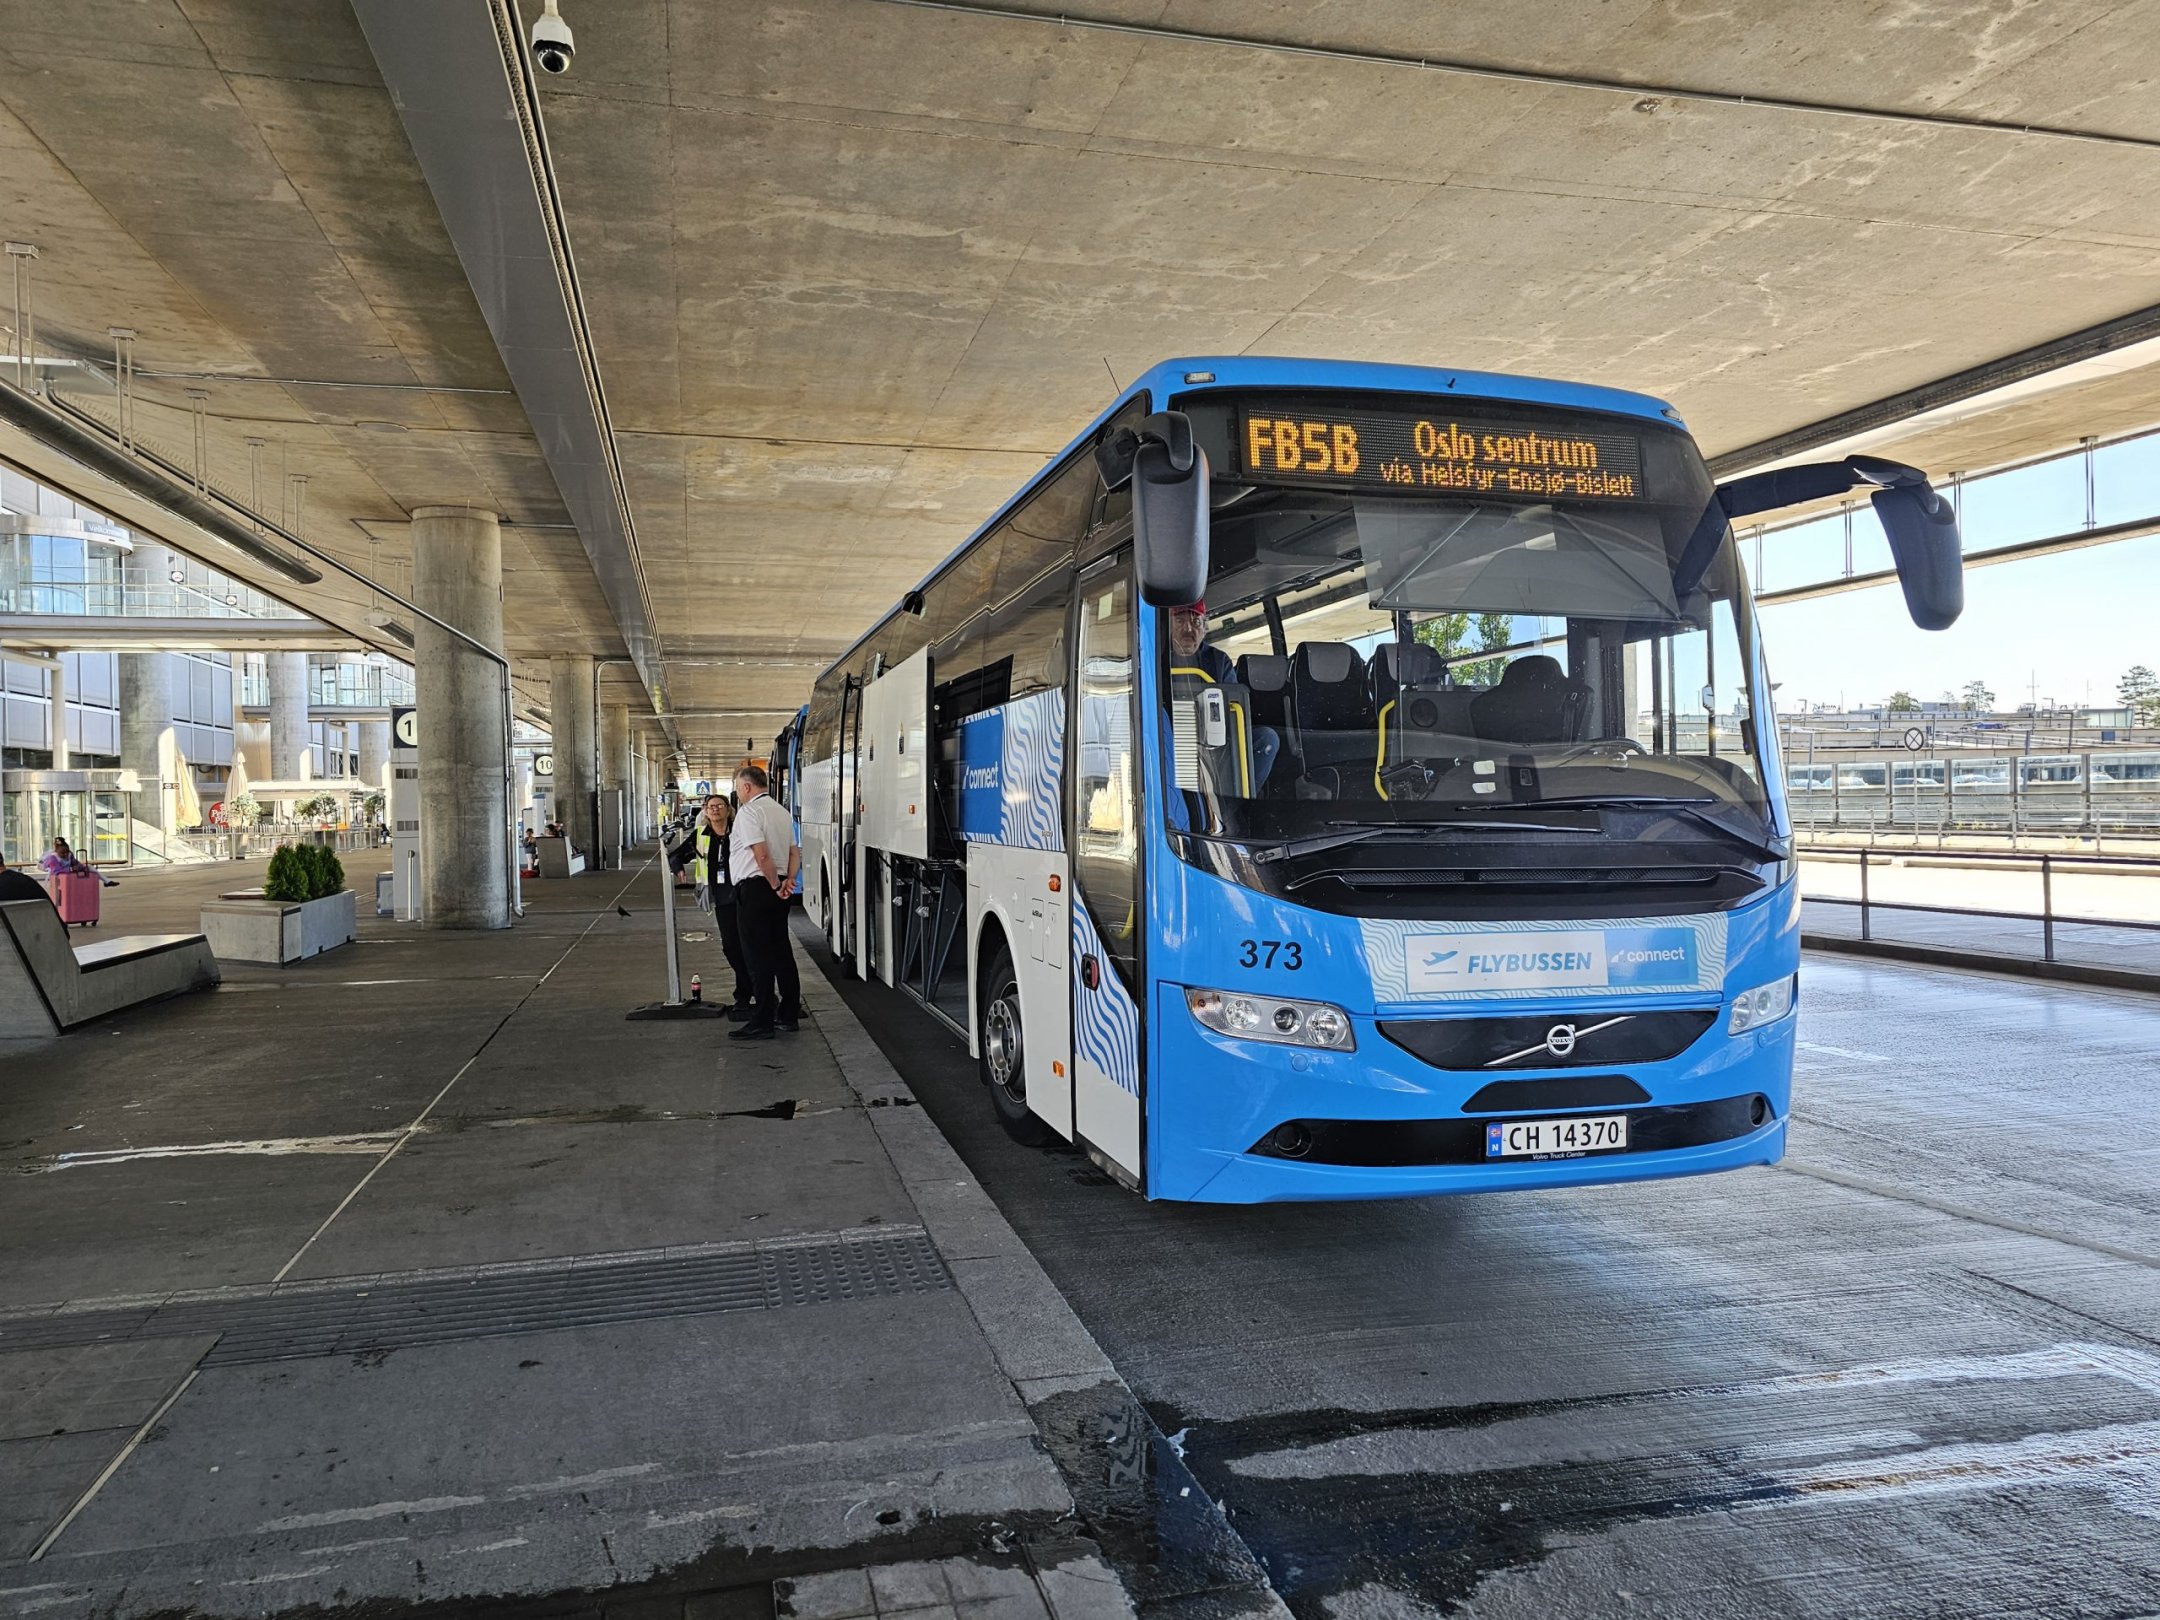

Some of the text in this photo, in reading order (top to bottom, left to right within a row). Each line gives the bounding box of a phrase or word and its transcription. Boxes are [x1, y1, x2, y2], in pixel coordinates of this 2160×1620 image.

[1248, 418, 1360, 474] FB5B
[1414, 420, 1598, 468] Oslo sentrum
[1380, 456, 1634, 498] via Helsfyr-Ensjø-Bislett
[969, 761, 999, 790] connect
[1239, 939, 1303, 971] 373
[1467, 952, 1592, 974] FLYBUSSEN
[1626, 946, 1685, 963] connect
[1491, 1143, 1499, 1152] N
[1509, 1120, 1619, 1151] CH 14370
[1532, 1153, 1549, 1161] Volvo
[1566, 1151, 1587, 1159] Center
